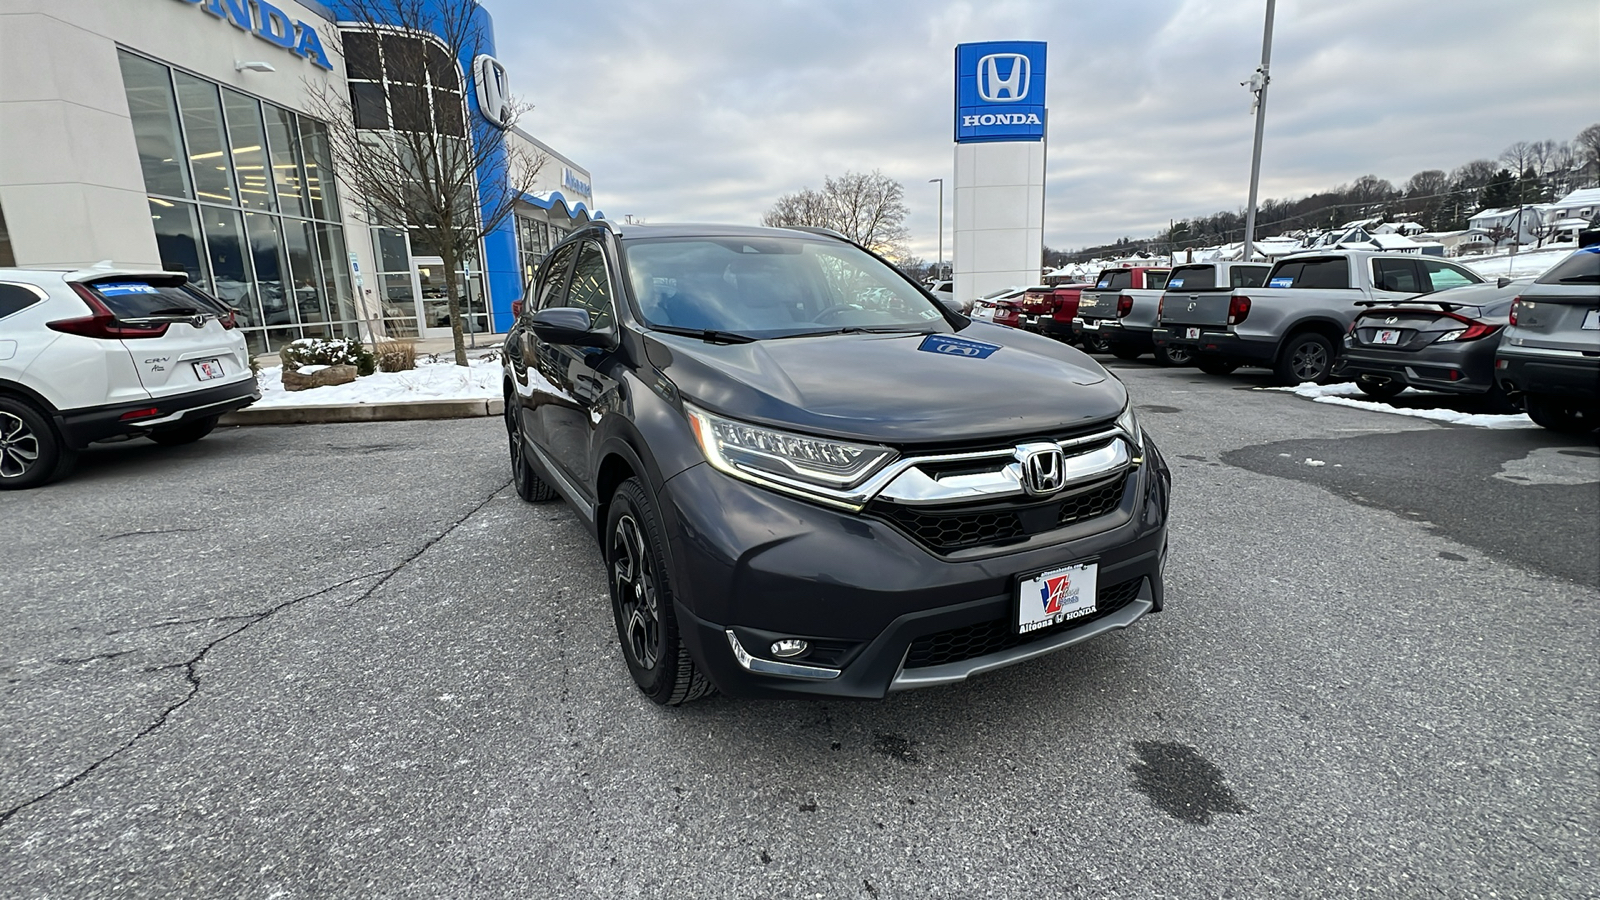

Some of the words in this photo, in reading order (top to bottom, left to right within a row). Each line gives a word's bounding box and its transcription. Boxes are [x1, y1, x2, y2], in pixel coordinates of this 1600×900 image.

[962, 113, 1042, 127] HONDA
[1019, 619, 1053, 633] Altoona
[1066, 605, 1097, 620] HONDA
